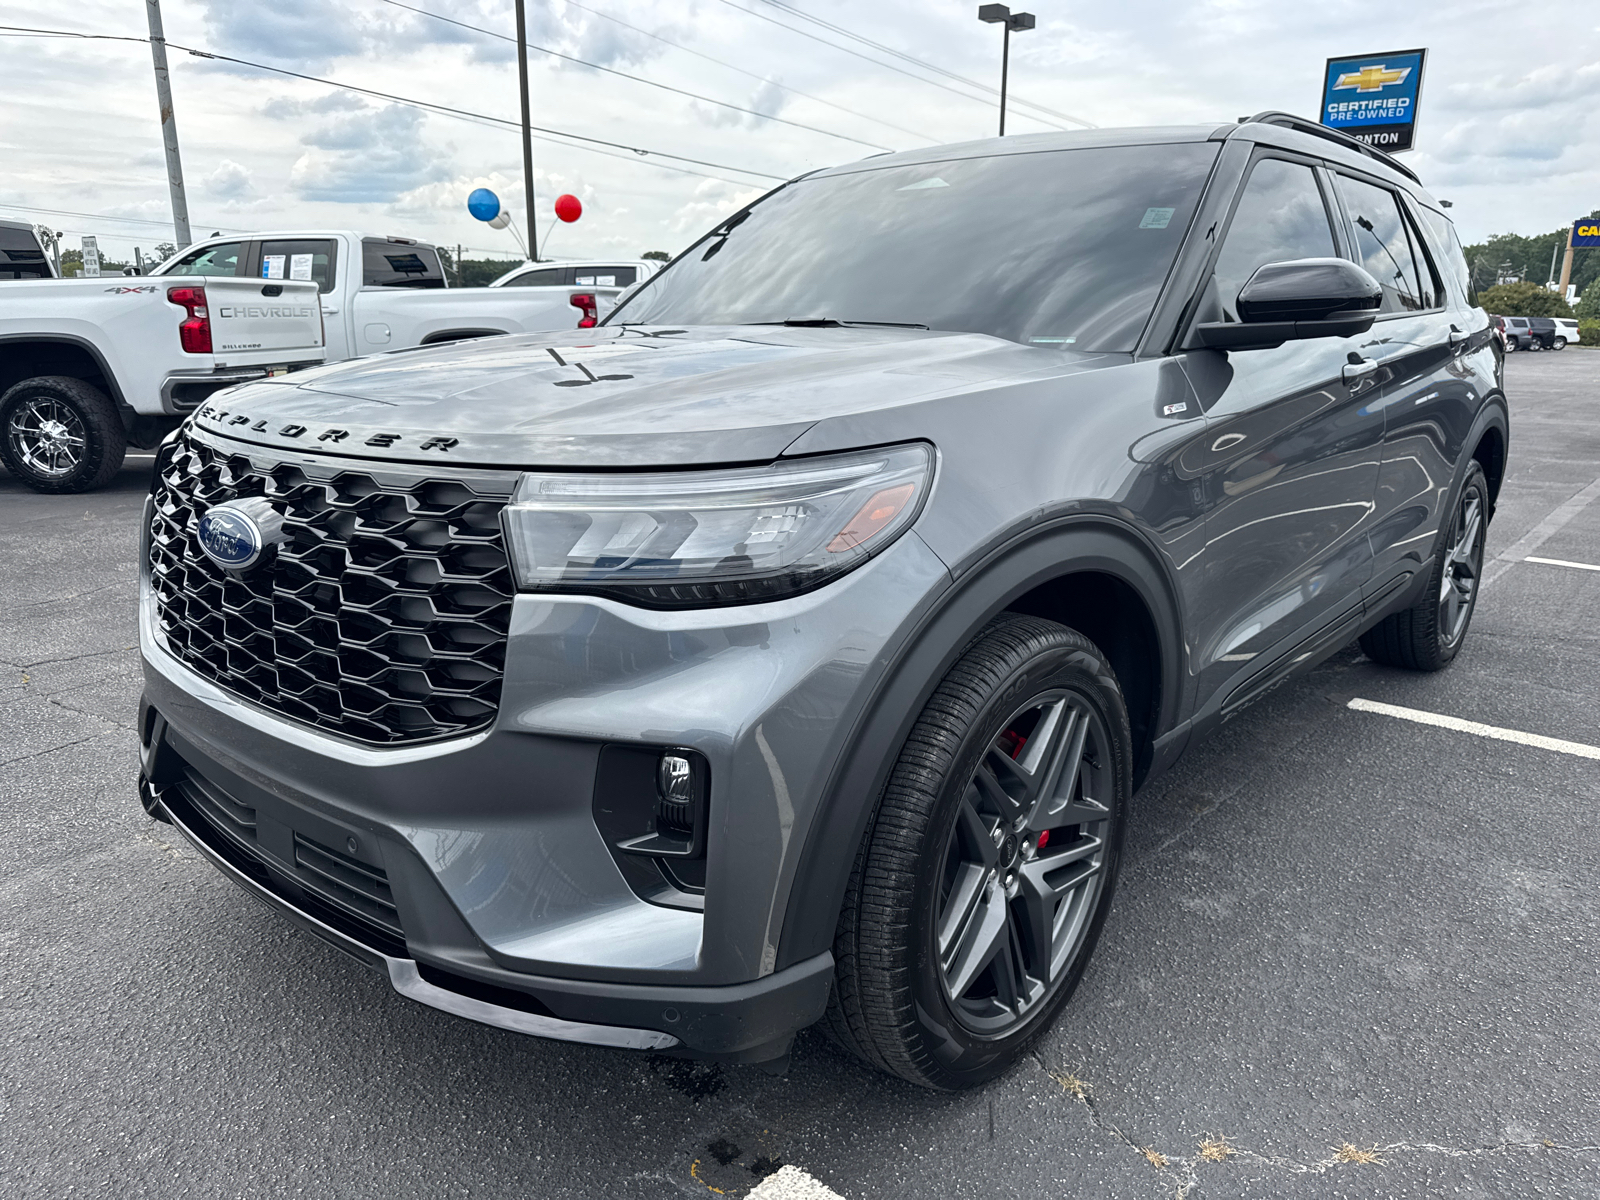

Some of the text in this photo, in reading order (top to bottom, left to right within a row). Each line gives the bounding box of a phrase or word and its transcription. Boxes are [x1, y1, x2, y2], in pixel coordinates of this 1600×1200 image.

[1328, 98, 1409, 112] CERTIFIED
[1330, 108, 1404, 121] PRE-OWNED
[1577, 225, 1600, 237] CA
[220, 307, 316, 318] CHEVROLET
[200, 406, 460, 452] EXPLORER
[205, 517, 242, 557] Ford
